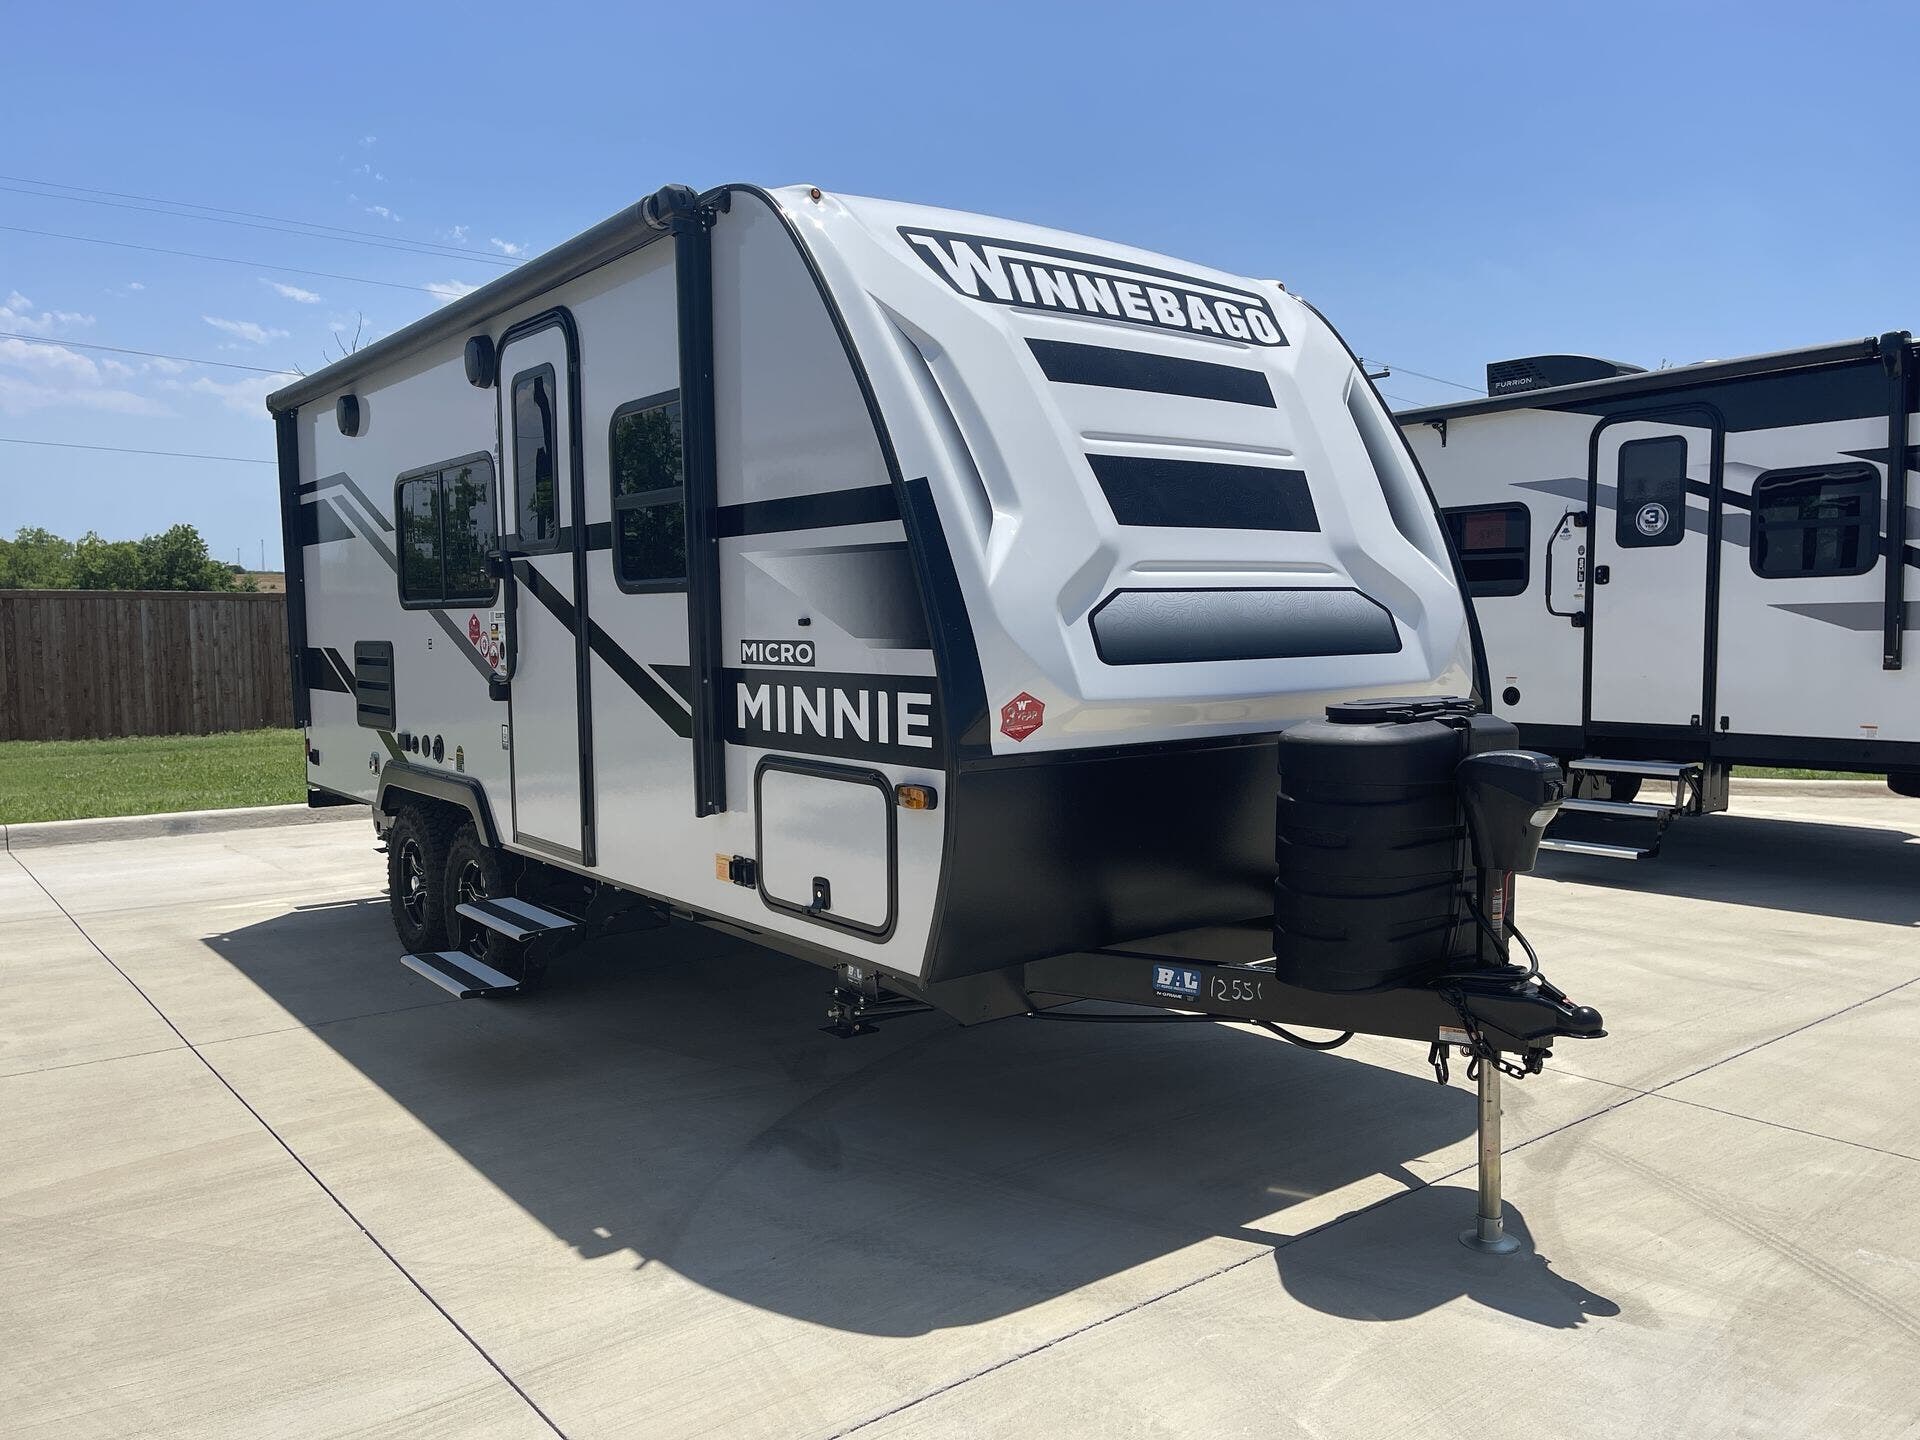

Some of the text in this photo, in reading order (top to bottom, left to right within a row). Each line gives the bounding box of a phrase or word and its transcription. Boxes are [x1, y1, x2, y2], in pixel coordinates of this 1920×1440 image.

[907, 233, 1282, 344] WINNEBAGO
[1495, 377, 1533, 389] FURRION
[1645, 509, 1660, 525] 3
[741, 642, 813, 664] MICRO
[737, 682, 933, 749] MINNIE
